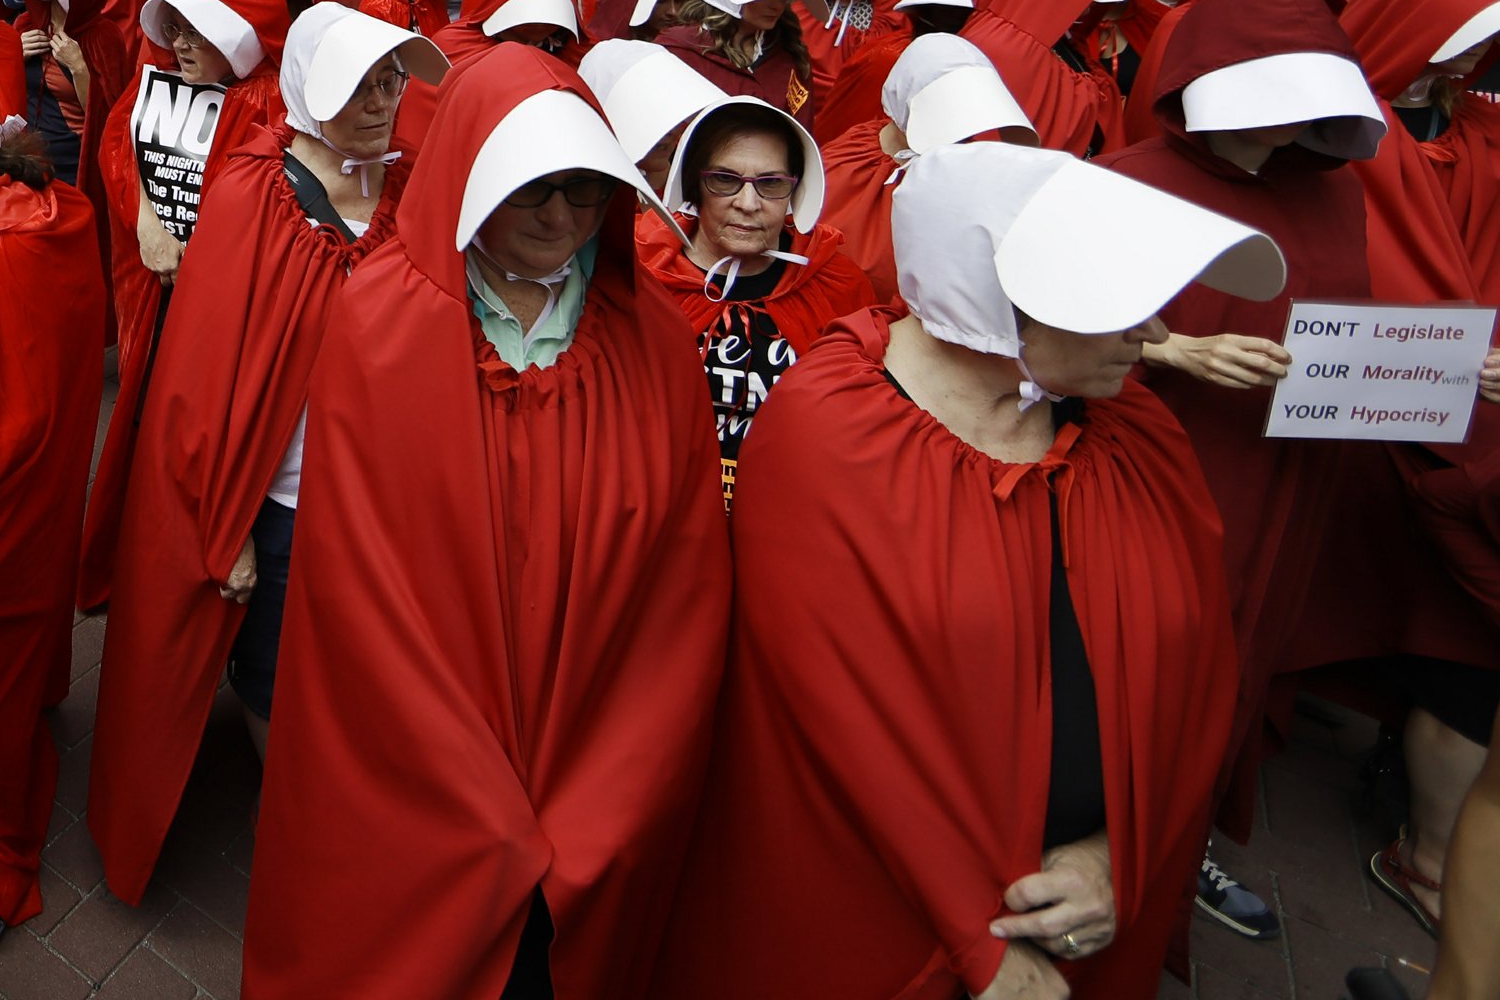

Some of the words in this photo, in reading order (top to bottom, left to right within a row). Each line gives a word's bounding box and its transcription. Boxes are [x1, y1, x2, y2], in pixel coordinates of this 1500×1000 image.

[143, 150, 166, 165] THIS
[154, 165, 186, 182] MUST
[185, 172, 204, 186] EN
[147, 178, 168, 198] The
[1293, 319, 1361, 337] DON'T
[1373, 323, 1465, 342] Legislate
[1305, 363, 1350, 379] OUR
[1362, 365, 1444, 385] Morality
[1441, 374, 1470, 386] with
[1283, 404, 1339, 420] YOUR
[1350, 406, 1450, 426] Hypocrisy
